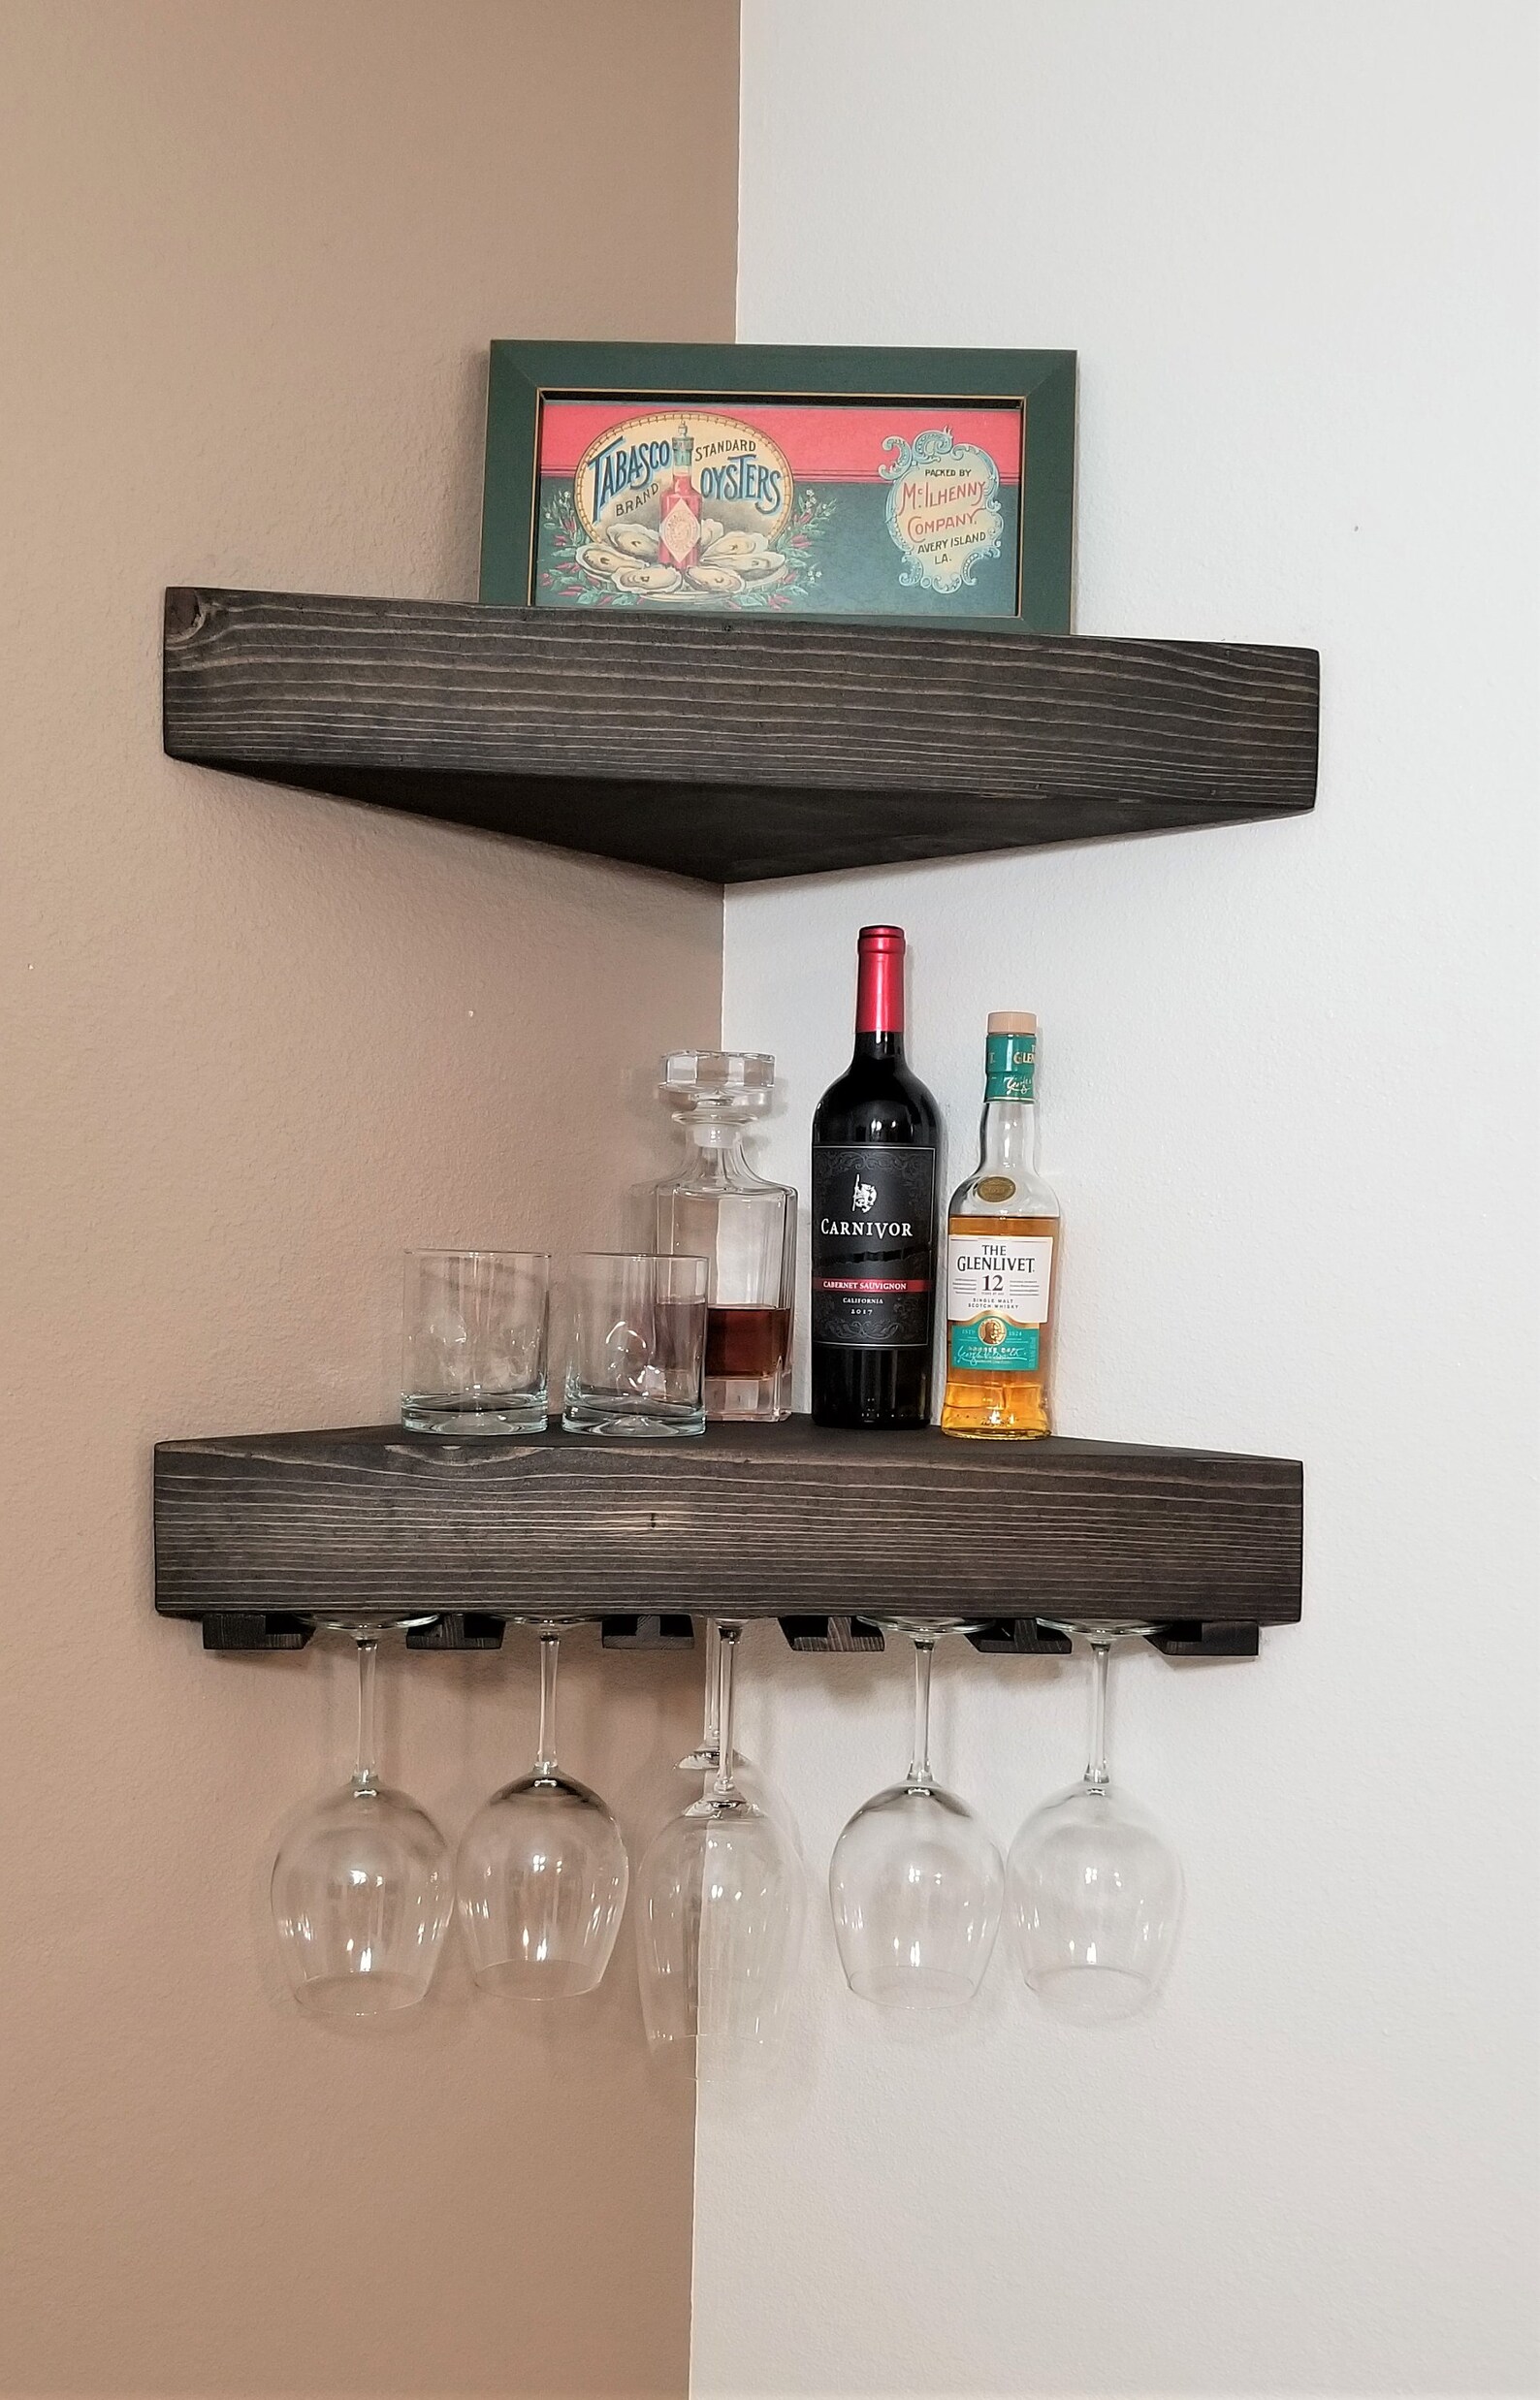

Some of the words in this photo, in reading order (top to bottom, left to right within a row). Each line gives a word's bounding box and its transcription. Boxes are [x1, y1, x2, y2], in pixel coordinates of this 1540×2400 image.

[694, 439, 756, 462] STANDARD
[588, 436, 669, 524] TABASCO
[924, 468, 956, 477] PACKED
[959, 468, 972, 477] BY
[700, 454, 782, 515] OYSTERS
[615, 482, 659, 517] BRAND
[917, 539, 949, 555] AVERY
[950, 531, 986, 547] ISLAND
[934, 554, 951, 564] LA.
[820, 1218, 914, 1239] CARNIVOR
[981, 1244, 1007, 1256] THE
[823, 1280, 857, 1290] CABERNET
[859, 1281, 907, 1291] SAUVIGNON
[982, 1274, 1004, 1292] 12
